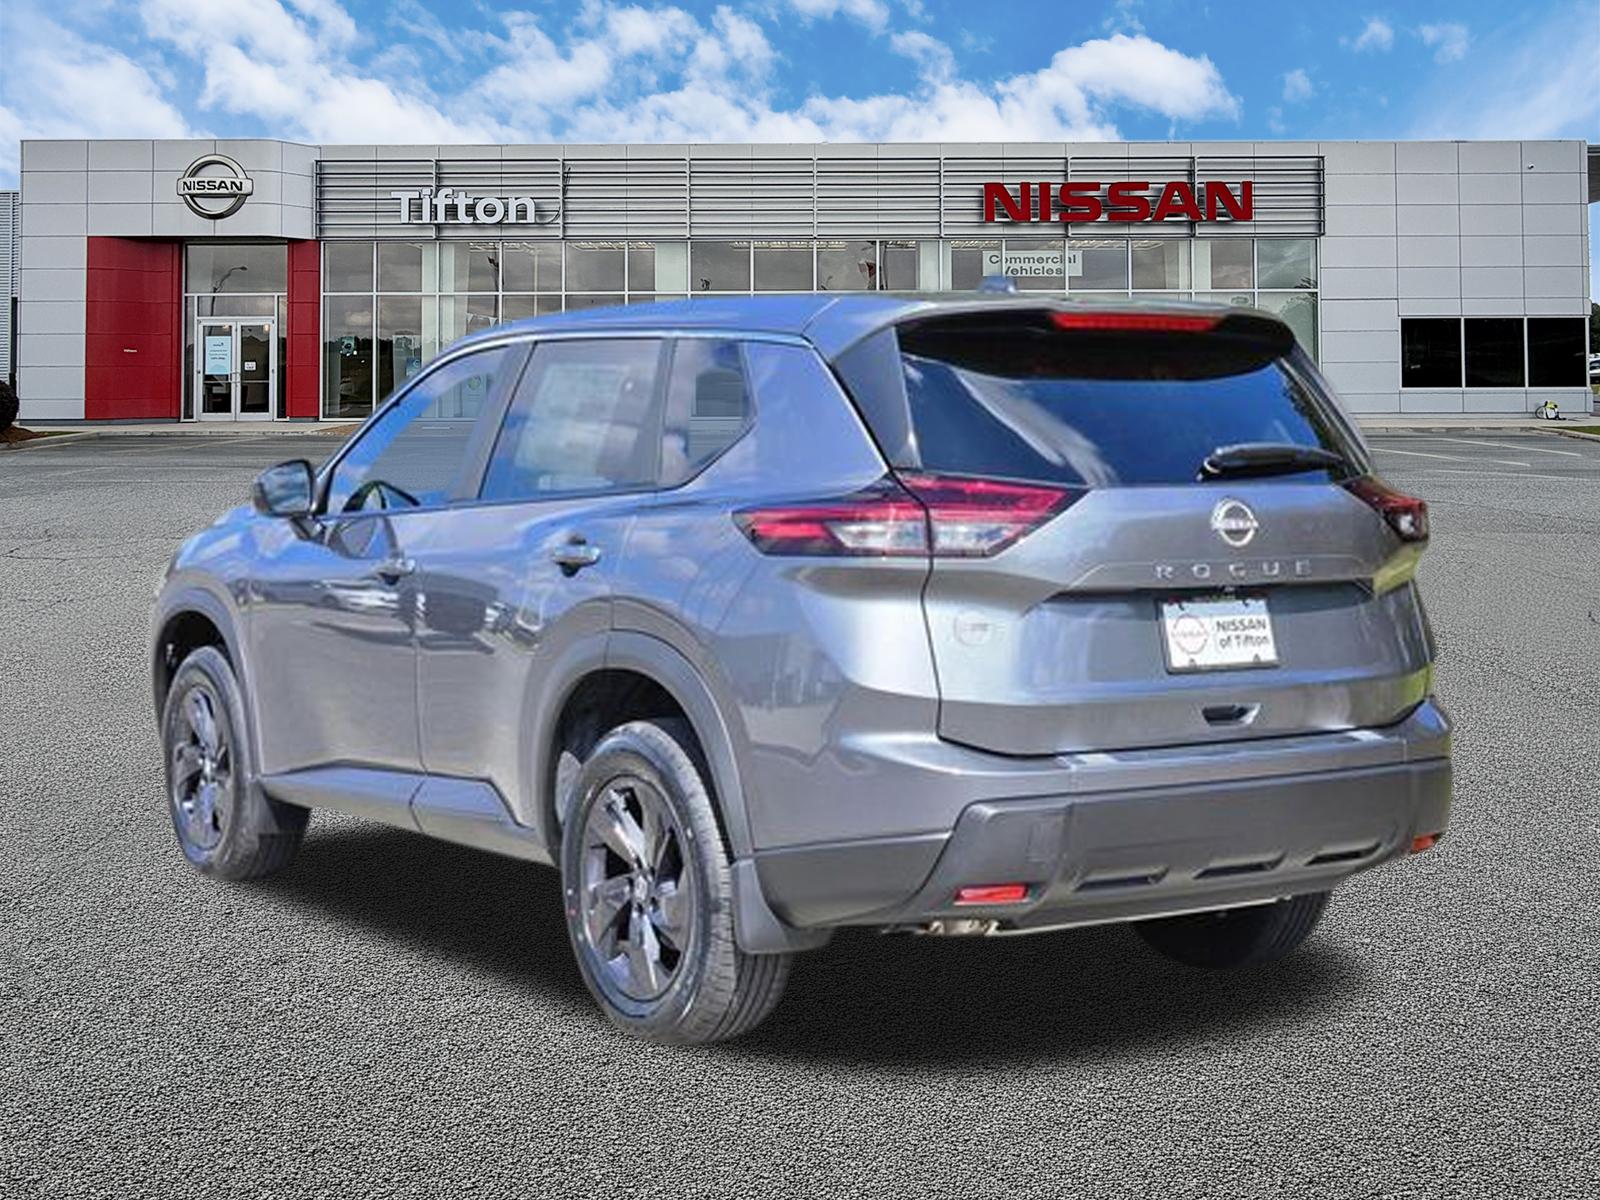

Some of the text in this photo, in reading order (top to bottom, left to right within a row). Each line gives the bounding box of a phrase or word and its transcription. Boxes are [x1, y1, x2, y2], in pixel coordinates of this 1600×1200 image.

[183, 180, 243, 192] NISSAN
[391, 188, 536, 224] Tifton
[984, 181, 1253, 221] NISSAN
[1155, 560, 1312, 579] ROGUE
[1216, 618, 1267, 632] NISSAN
[1219, 635, 1231, 649] of
